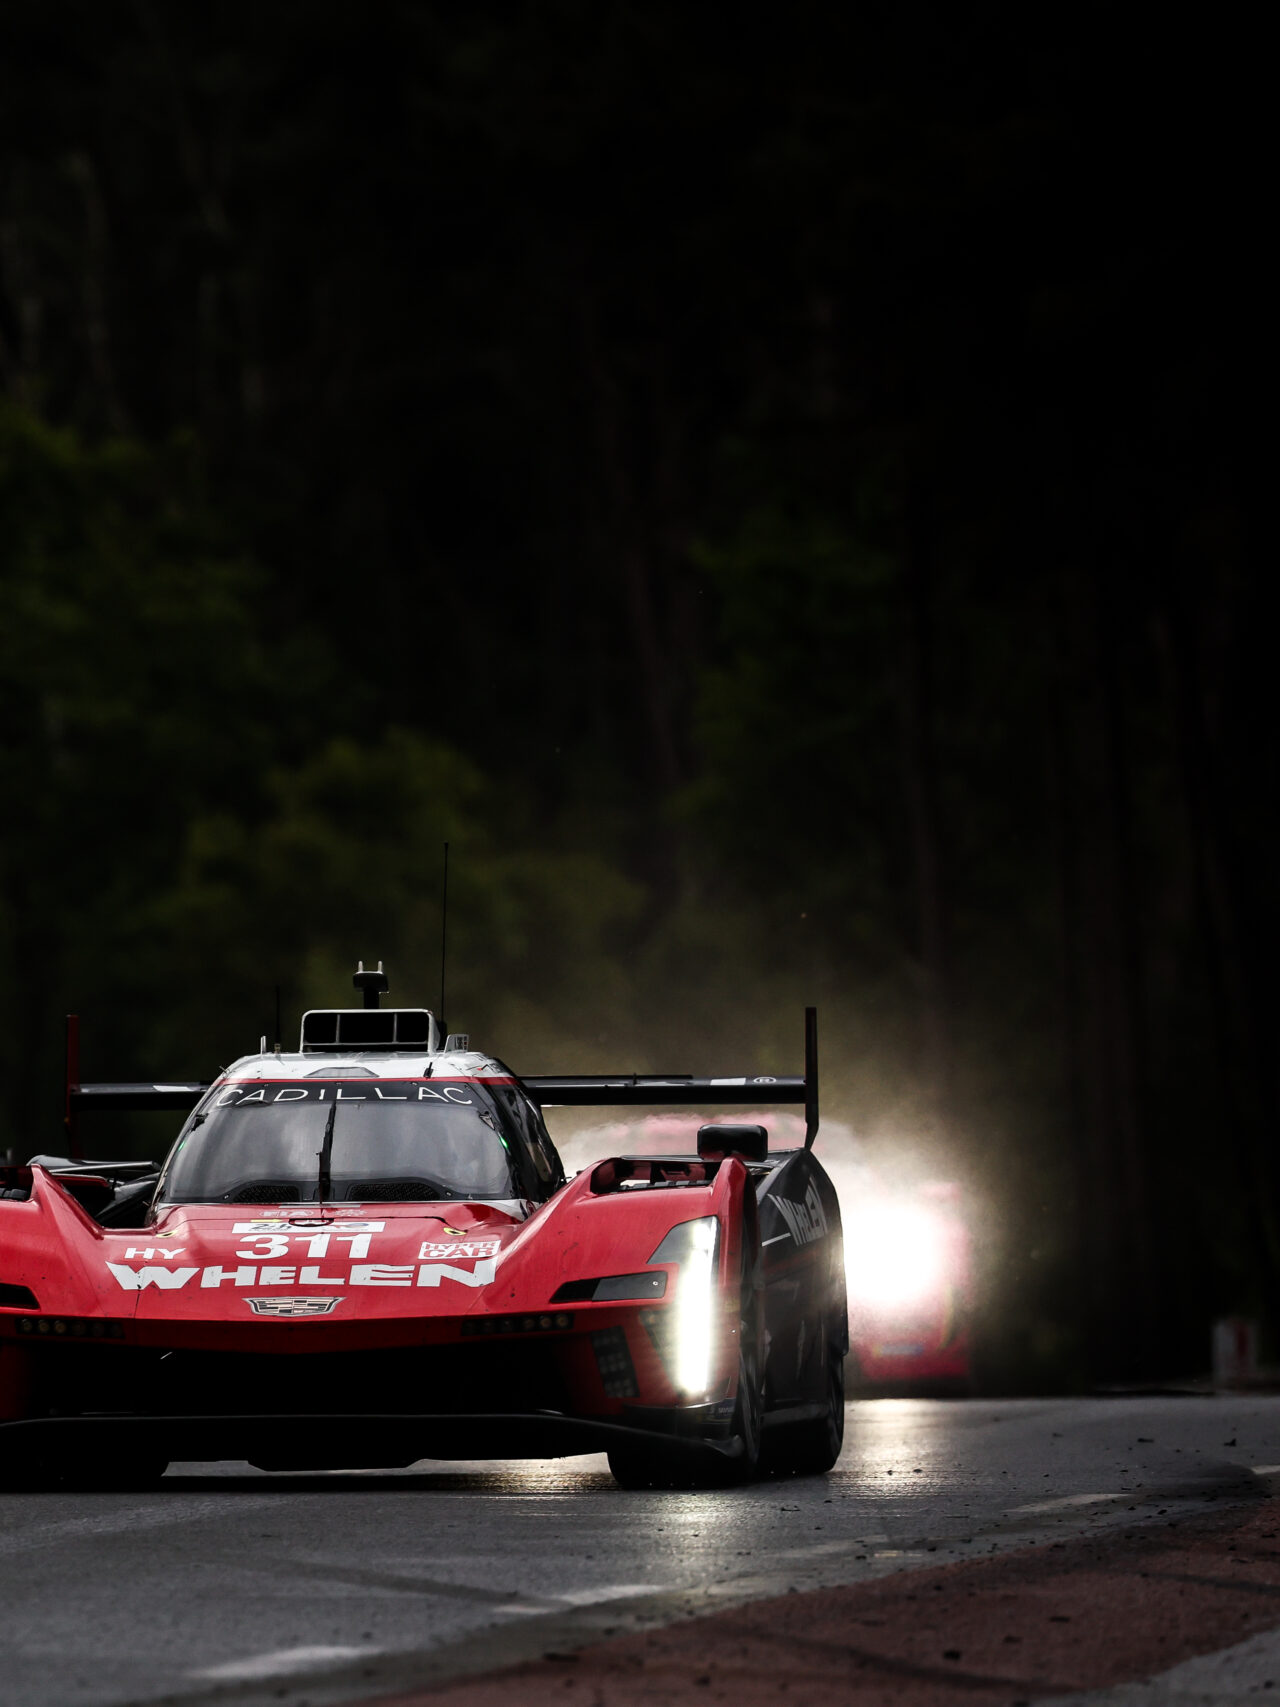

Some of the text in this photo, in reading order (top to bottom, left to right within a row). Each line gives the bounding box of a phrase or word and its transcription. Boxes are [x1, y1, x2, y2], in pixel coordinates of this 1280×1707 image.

[216, 1087, 472, 1106] CADILLAC
[124, 1247, 186, 1260] HY
[235, 1233, 373, 1260] 311
[423, 1248, 494, 1258] CAR
[424, 1242, 496, 1250] HYPER
[105, 1256, 498, 1290] WHELEN
